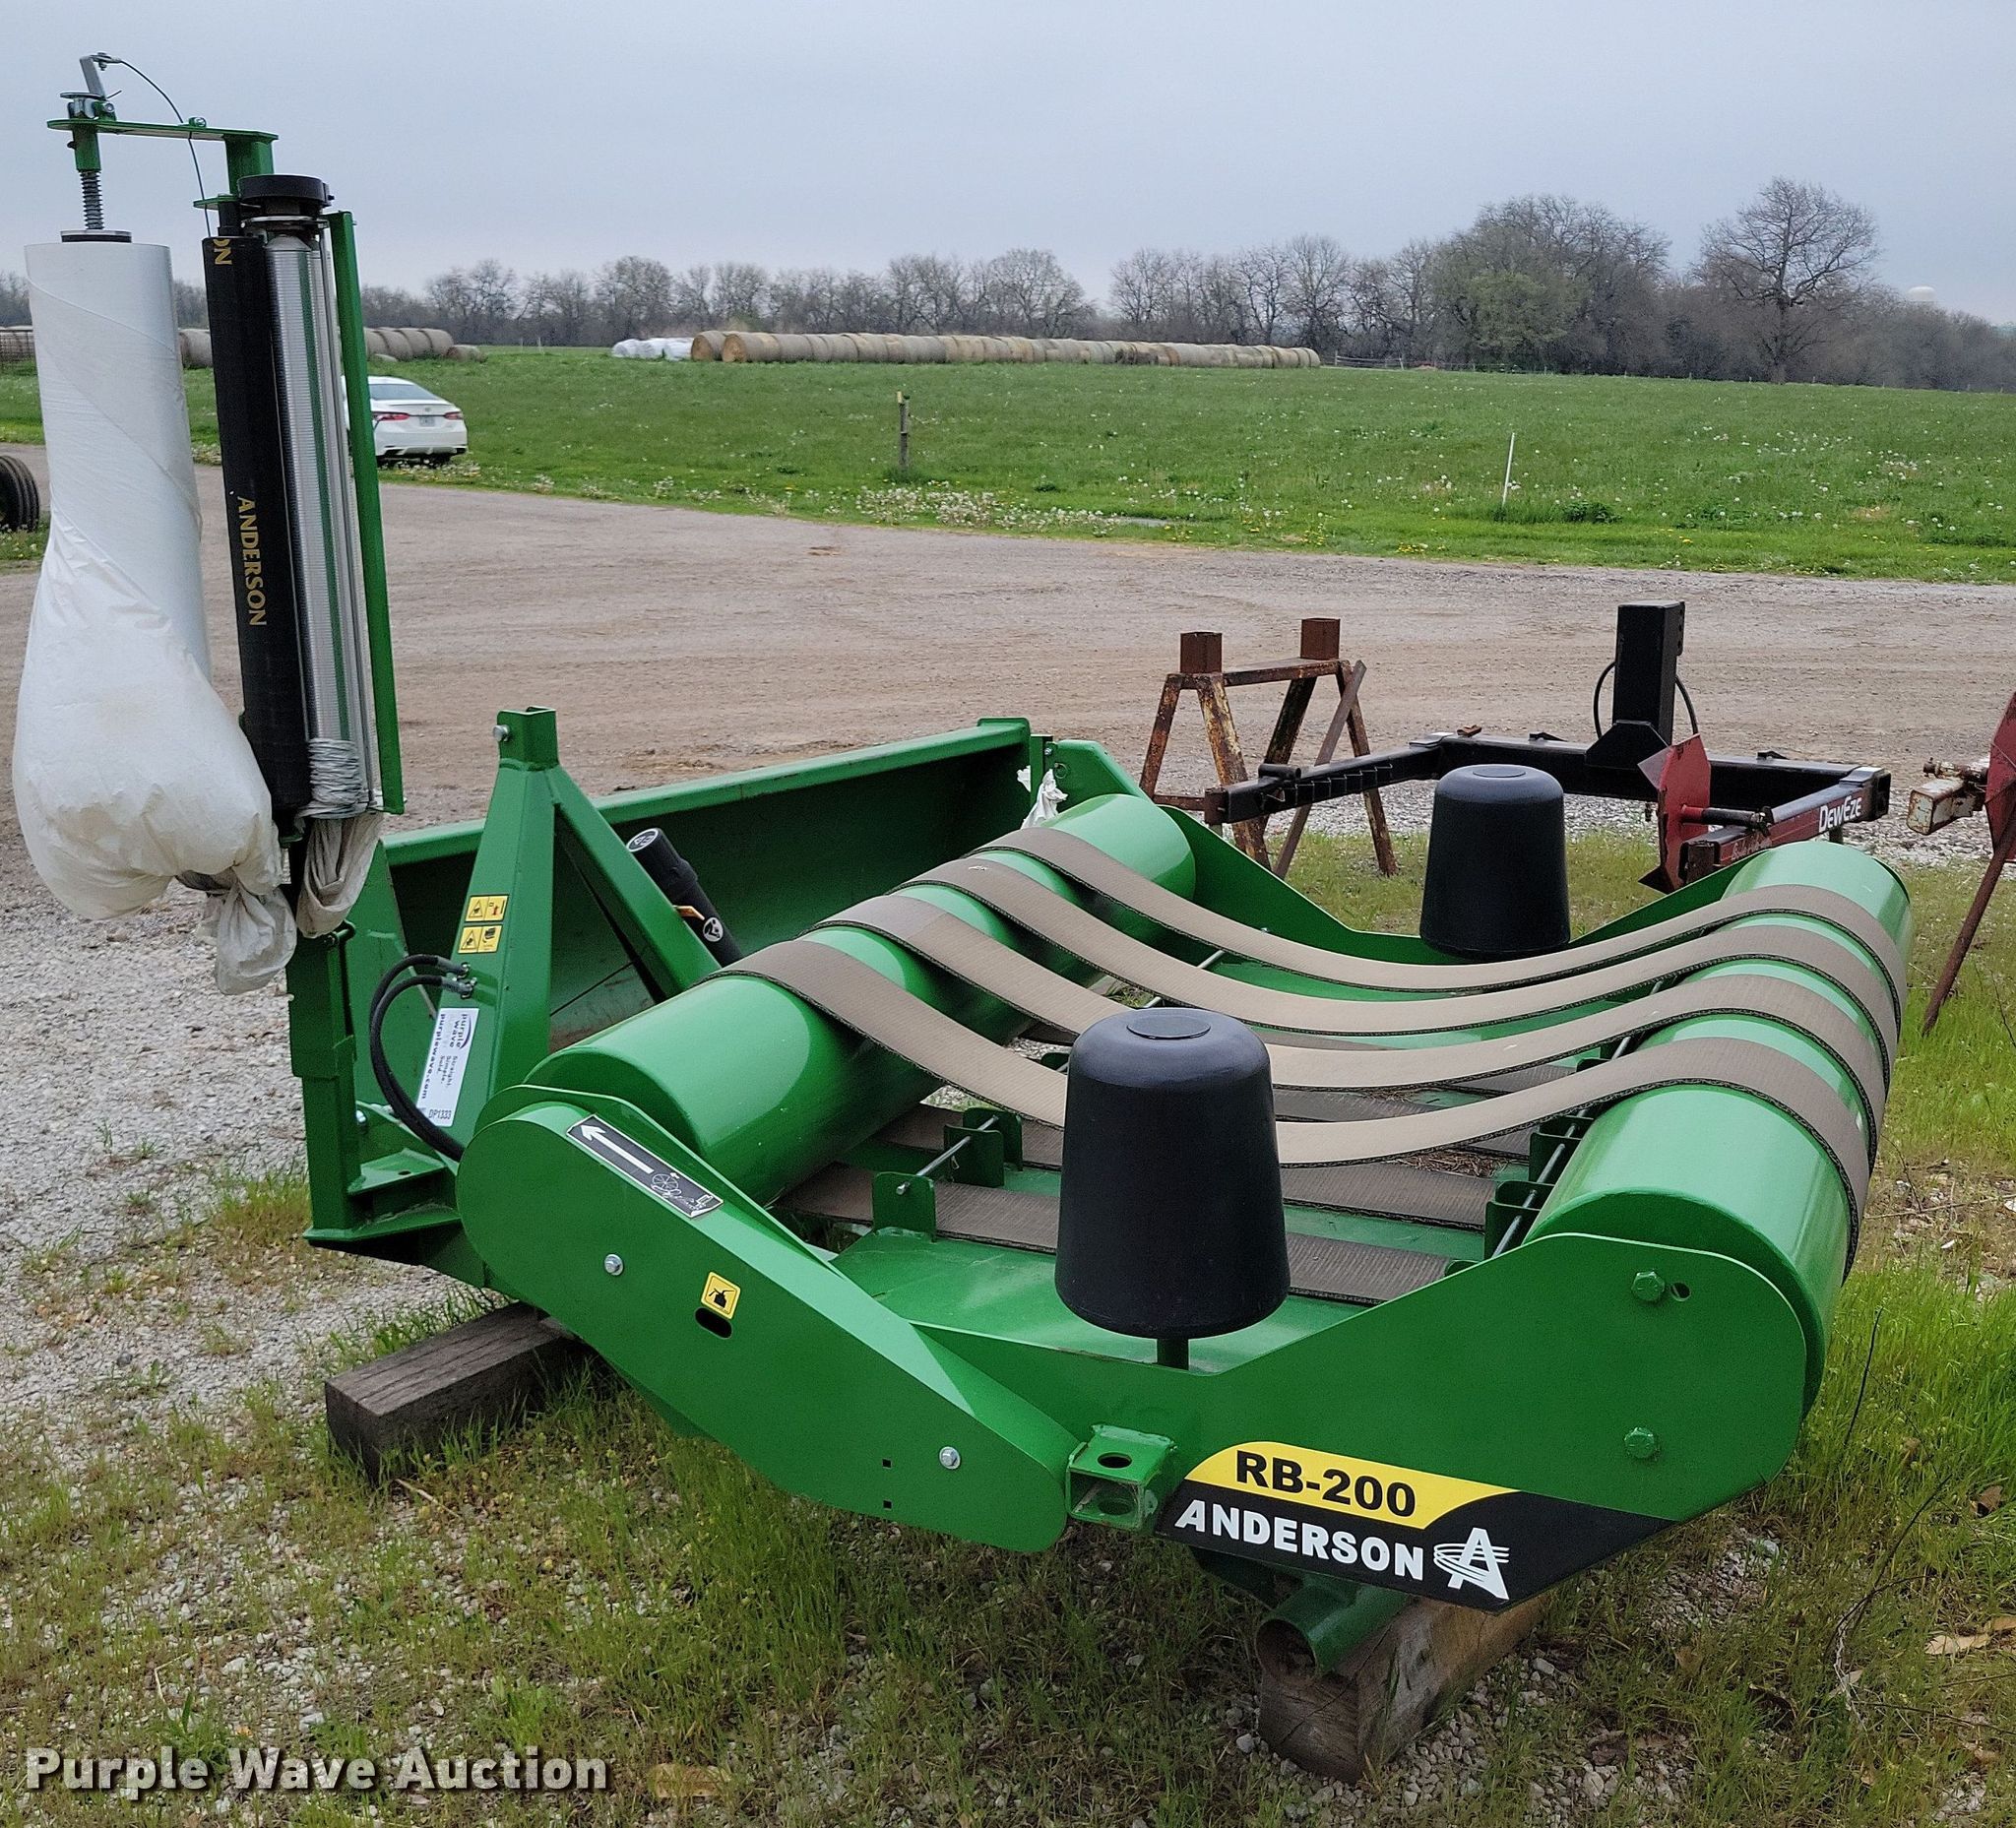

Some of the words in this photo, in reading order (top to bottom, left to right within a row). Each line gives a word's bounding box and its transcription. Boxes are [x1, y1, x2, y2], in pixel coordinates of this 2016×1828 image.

[237, 496, 268, 626] ANDERSON
[421, 1014, 446, 1100] purplewave.com
[449, 1020, 461, 1048] wave
[456, 1014, 468, 1048] purple
[428, 1108, 452, 1120] DP1333
[1236, 1450, 1416, 1517] RB-200
[1175, 1500, 1424, 1581] ANDERSON
